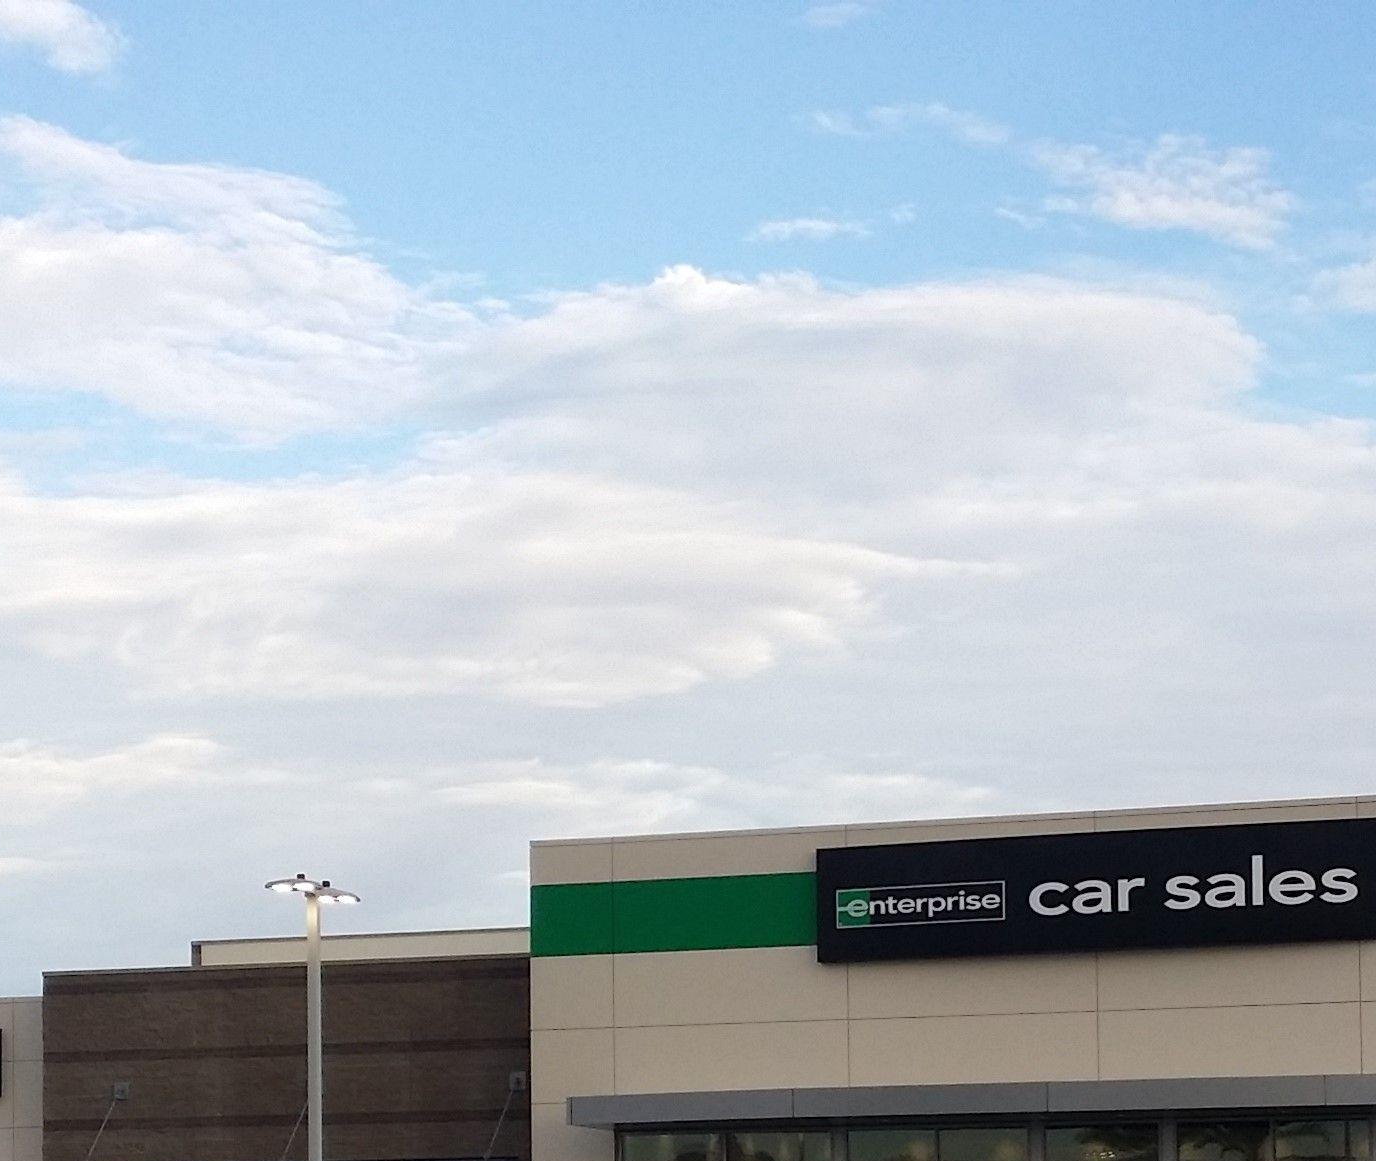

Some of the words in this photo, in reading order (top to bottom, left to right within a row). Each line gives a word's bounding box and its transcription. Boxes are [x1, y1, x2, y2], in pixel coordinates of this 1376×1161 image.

[845, 888, 1001, 919] enterprise
[1028, 875, 1146, 917] car
[1163, 854, 1359, 912] sales
